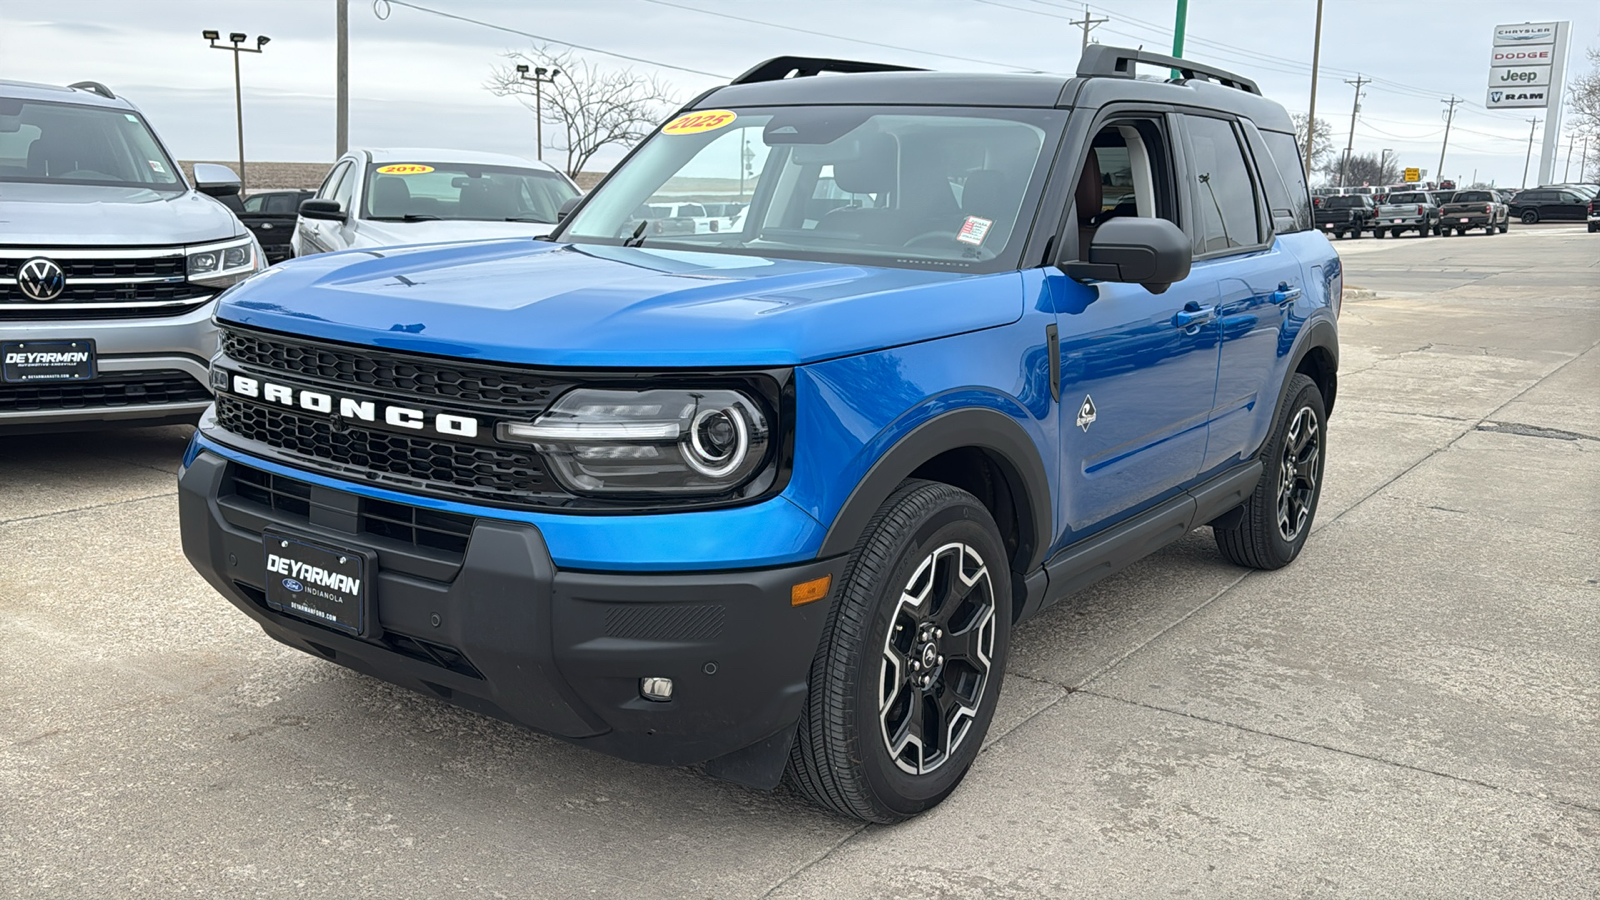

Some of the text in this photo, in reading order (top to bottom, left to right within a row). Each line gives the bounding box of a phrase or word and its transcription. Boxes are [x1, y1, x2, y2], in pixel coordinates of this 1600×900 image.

[1498, 27, 1550, 35] CHRYSLER
[1494, 51, 1549, 60] DODGE
[1501, 69, 1537, 83] Jeep
[666, 114, 732, 130] 2025
[5, 352, 88, 363] DEYARMAN
[233, 375, 478, 438] BRONCO
[267, 554, 360, 596] DEYARMAN
[304, 586, 343, 603] INDIANOLA
[291, 602, 337, 622] DEYARMANFORD.COM
